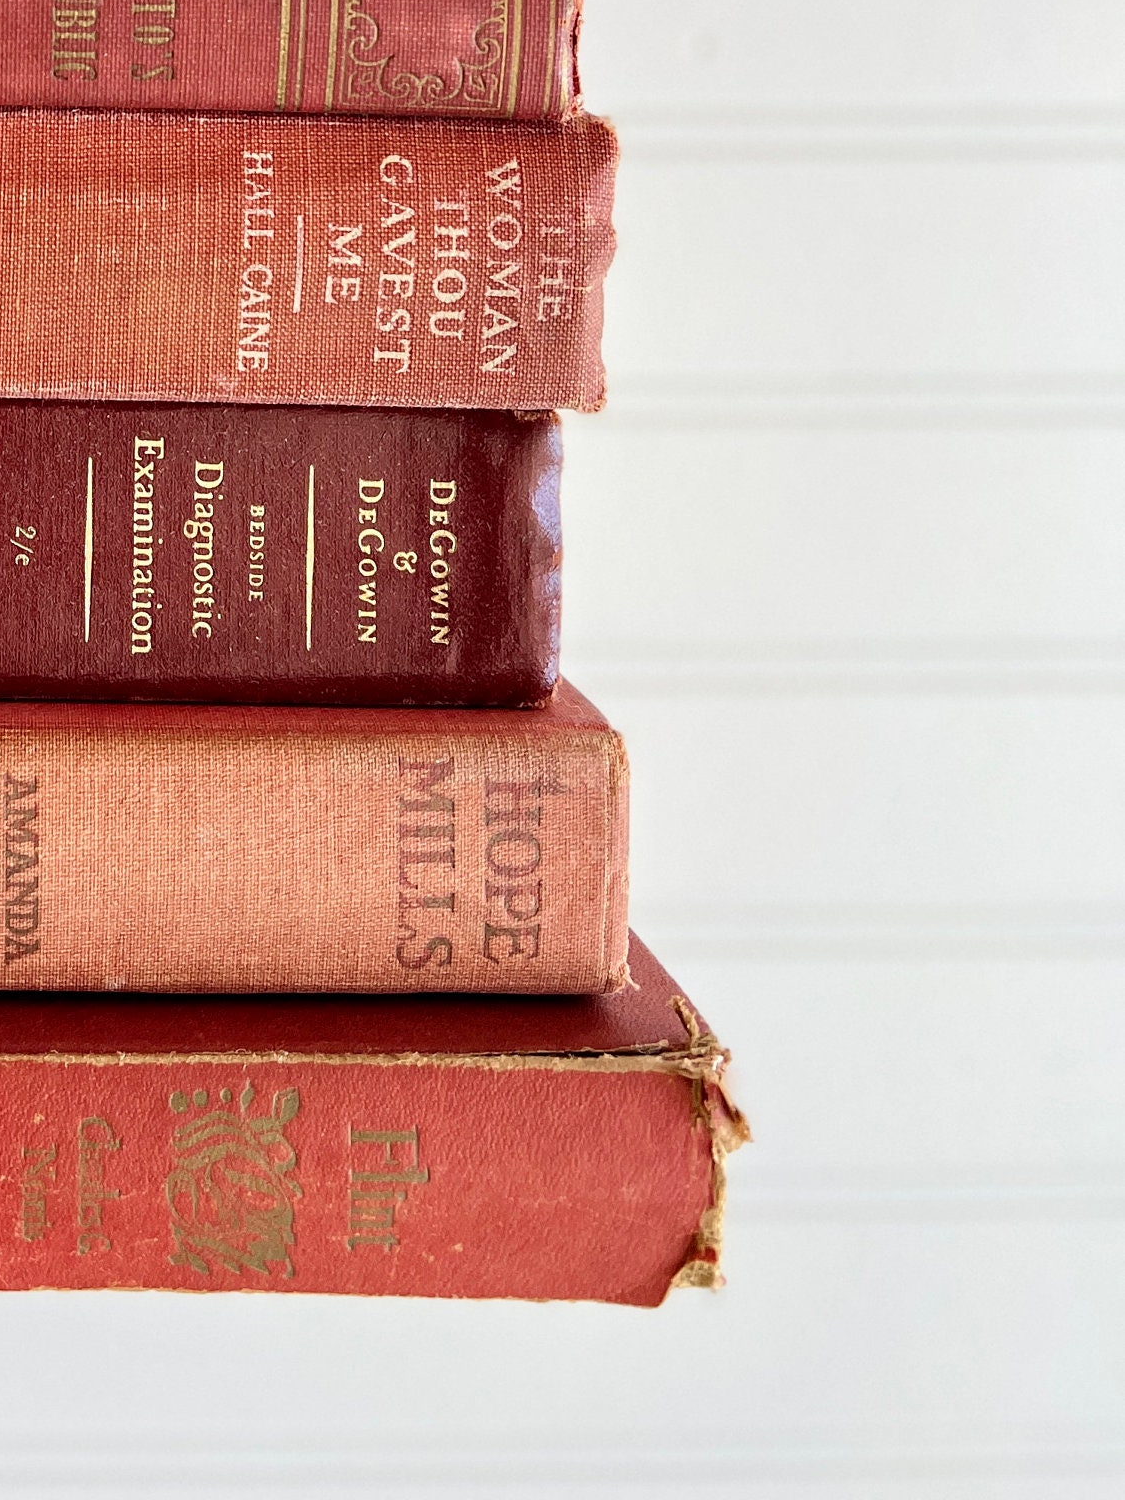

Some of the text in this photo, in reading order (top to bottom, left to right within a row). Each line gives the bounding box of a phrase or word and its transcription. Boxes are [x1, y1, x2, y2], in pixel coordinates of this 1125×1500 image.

[237, 151, 275, 372] HALL CAINE
[325, 223, 362, 305] ME
[373, 154, 415, 374] GAVEST
[429, 188, 470, 341] THOU
[480, 157, 523, 375] WOMAN
[537, 215, 574, 322] THE
[11, 525, 36, 567] 2/e
[129, 435, 165, 655] Examination
[183, 460, 224, 639] Diagnostic
[247, 505, 266, 603] BEDSIDE
[393, 551, 418, 574] &
[2, 771, 40, 967] AMANDA
[395, 756, 455, 972] MILLS
[481, 777, 542, 966] HOPE
[347, 1124, 432, 1253] Flint
